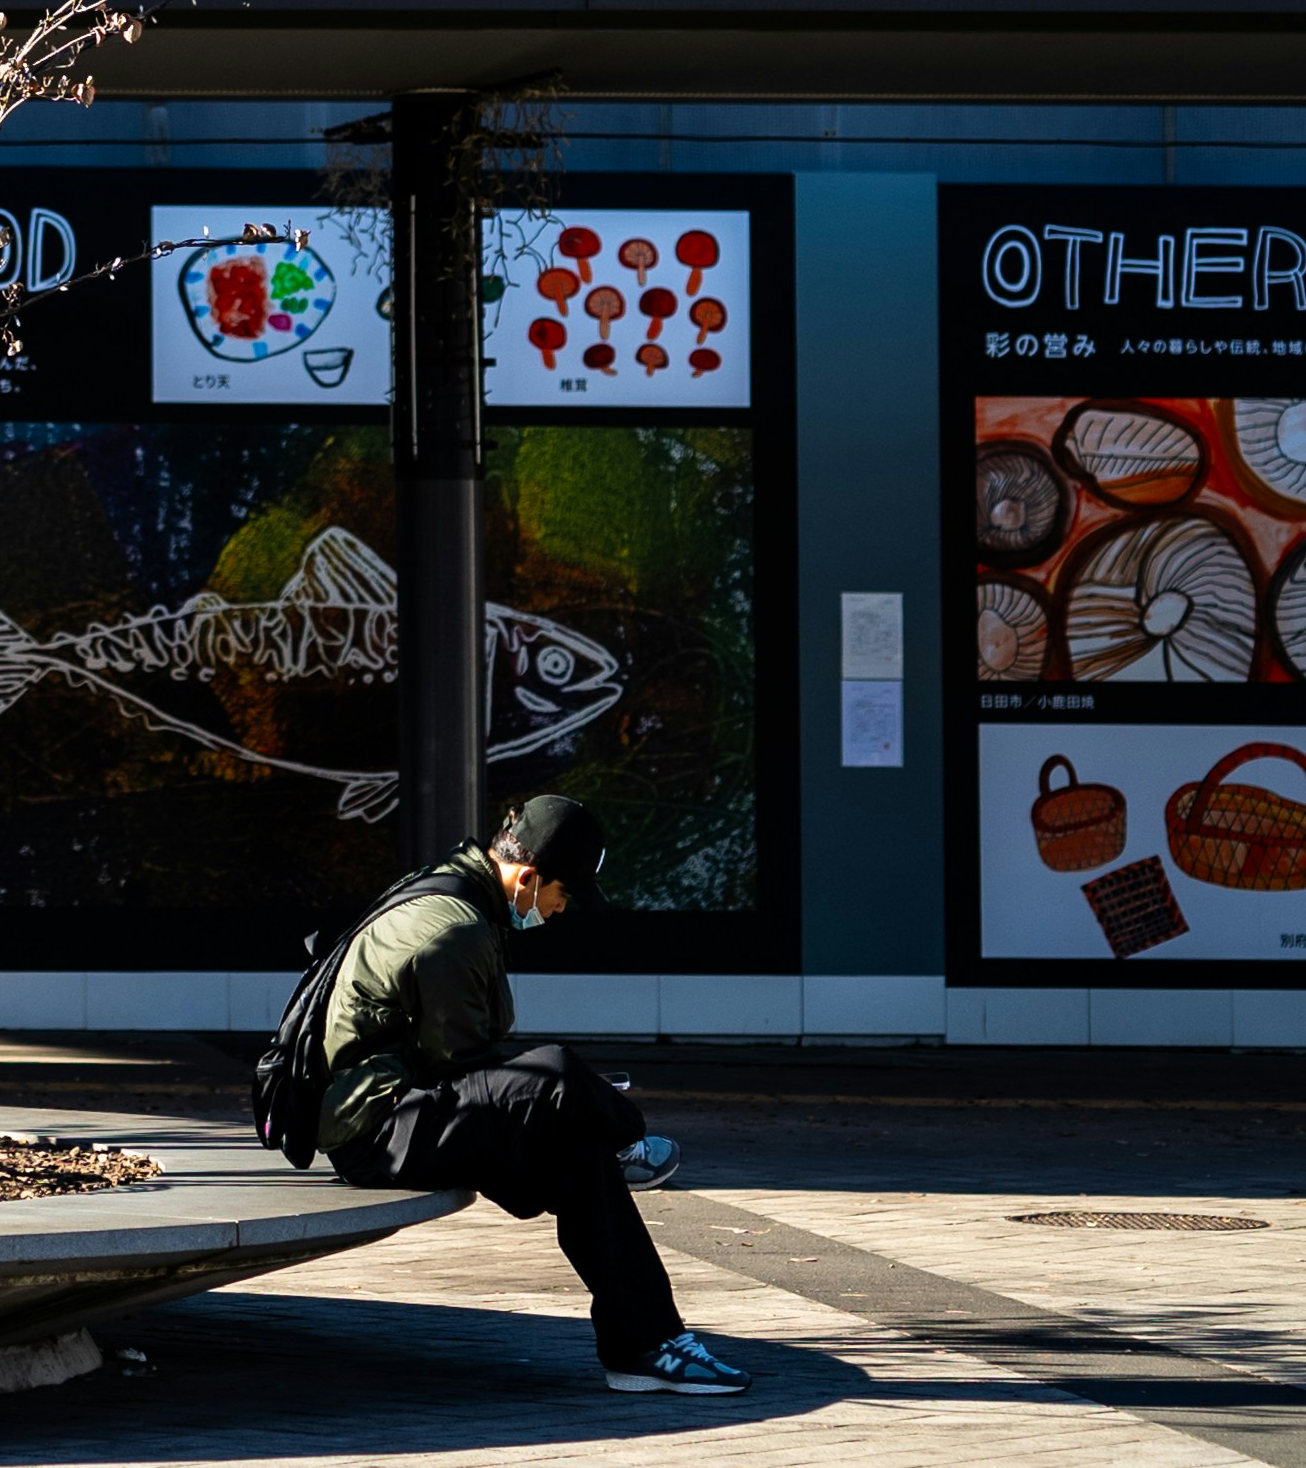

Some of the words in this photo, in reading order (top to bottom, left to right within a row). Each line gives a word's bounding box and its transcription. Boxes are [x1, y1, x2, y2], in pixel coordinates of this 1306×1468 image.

[982, 224, 1306, 310] OTHER
[984, 332, 1097, 359] 彩の営み
[1120, 339, 1306, 356] 人々の暮らしや伝統、地域
[192, 374, 231, 390] とり天
[654, 1352, 683, 1374] N
